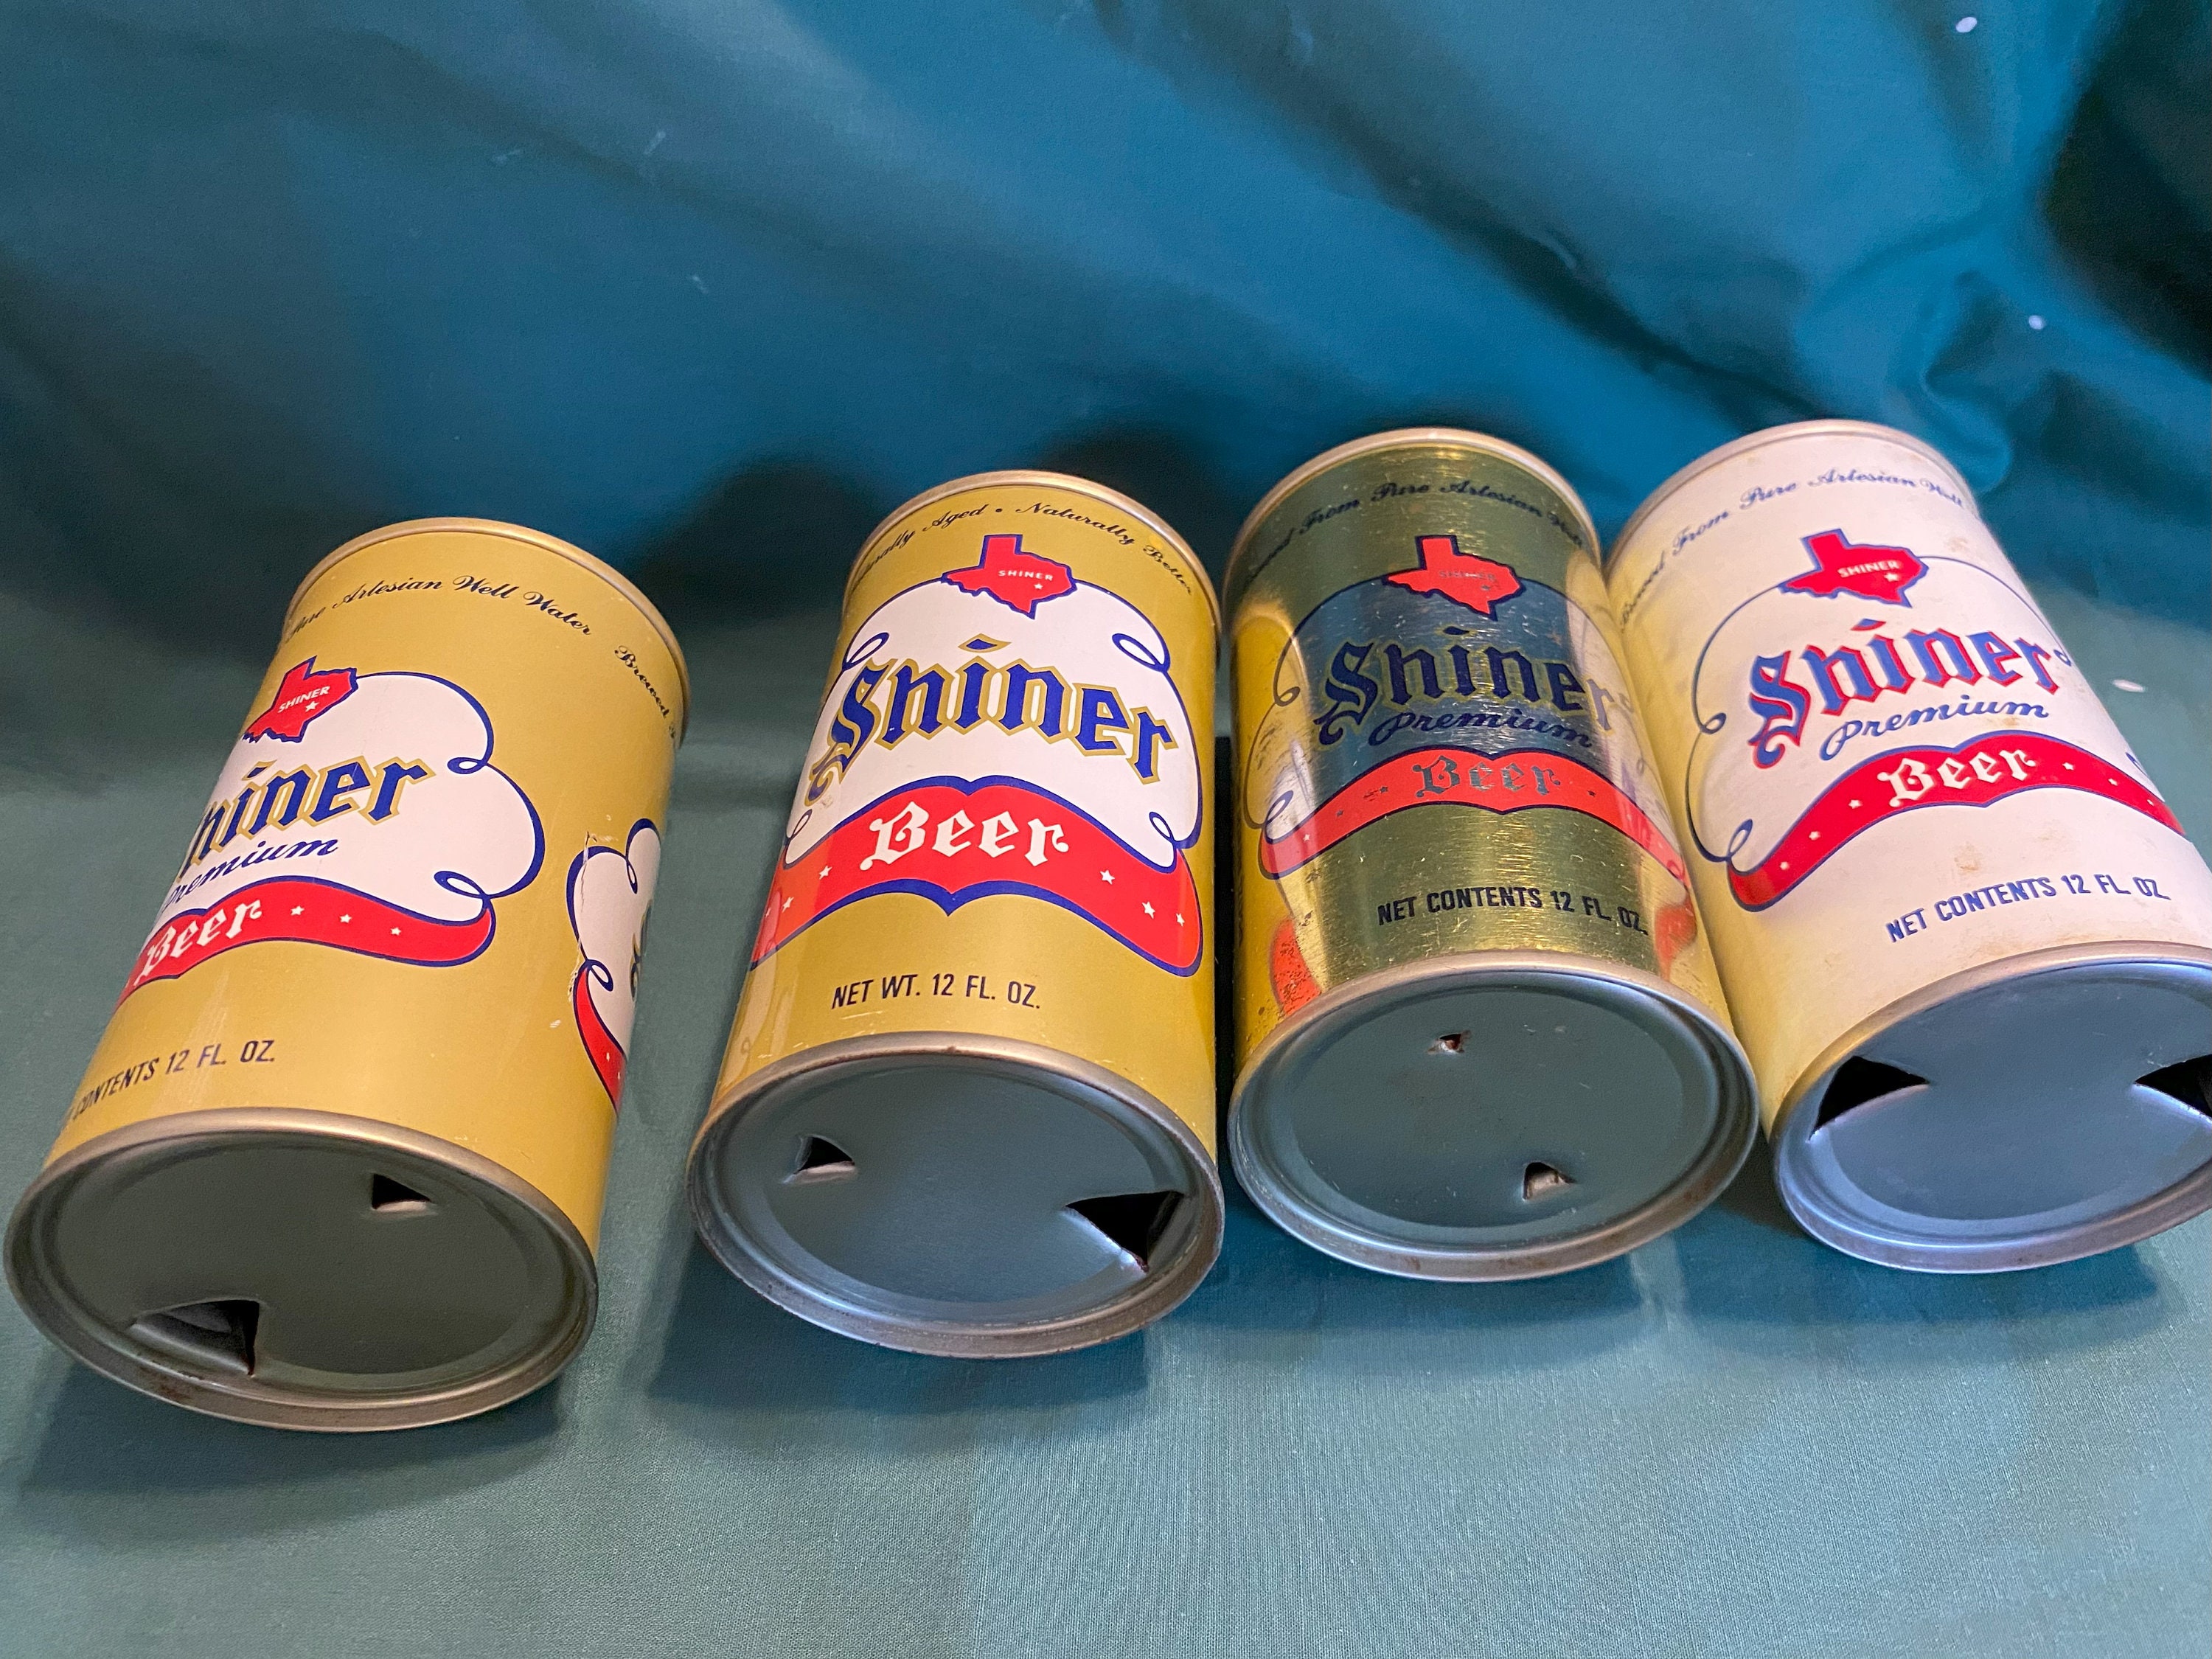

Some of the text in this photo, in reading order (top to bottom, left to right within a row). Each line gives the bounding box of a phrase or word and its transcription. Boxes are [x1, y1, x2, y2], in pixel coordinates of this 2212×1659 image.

[1739, 481, 1798, 510] Pure
[1807, 468, 1916, 489] Artesian
[922, 504, 985, 532] Aged
[1015, 501, 1135, 546] Naturally
[998, 569, 1054, 582] SHINER
[1837, 559, 1901, 580] SHINER
[332, 577, 442, 609] Artesian
[452, 575, 519, 599] Well
[524, 591, 591, 636] Water
[278, 685, 330, 713] SHINER
[615, 645, 669, 718] Brewed
[1313, 625, 1615, 751] Shiner
[1747, 618, 2060, 769] Shiner
[804, 633, 1179, 807] Shiner
[1412, 755, 1562, 799] Beer
[1877, 747, 2036, 808] Beer
[177, 755, 437, 883] hiner
[860, 801, 1069, 871] Beer
[1377, 896, 1416, 926] NET
[1426, 886, 1543, 914] CONTENTS
[1550, 890, 1575, 913] 12
[1885, 908, 1928, 943] NET
[1934, 876, 2057, 922] CONTENTS
[2061, 874, 2091, 895] 12
[133, 900, 262, 987] Beer
[832, 973, 1040, 1009] NET WT. 12 FL. OZ.
[165, 1050, 190, 1074] 12
